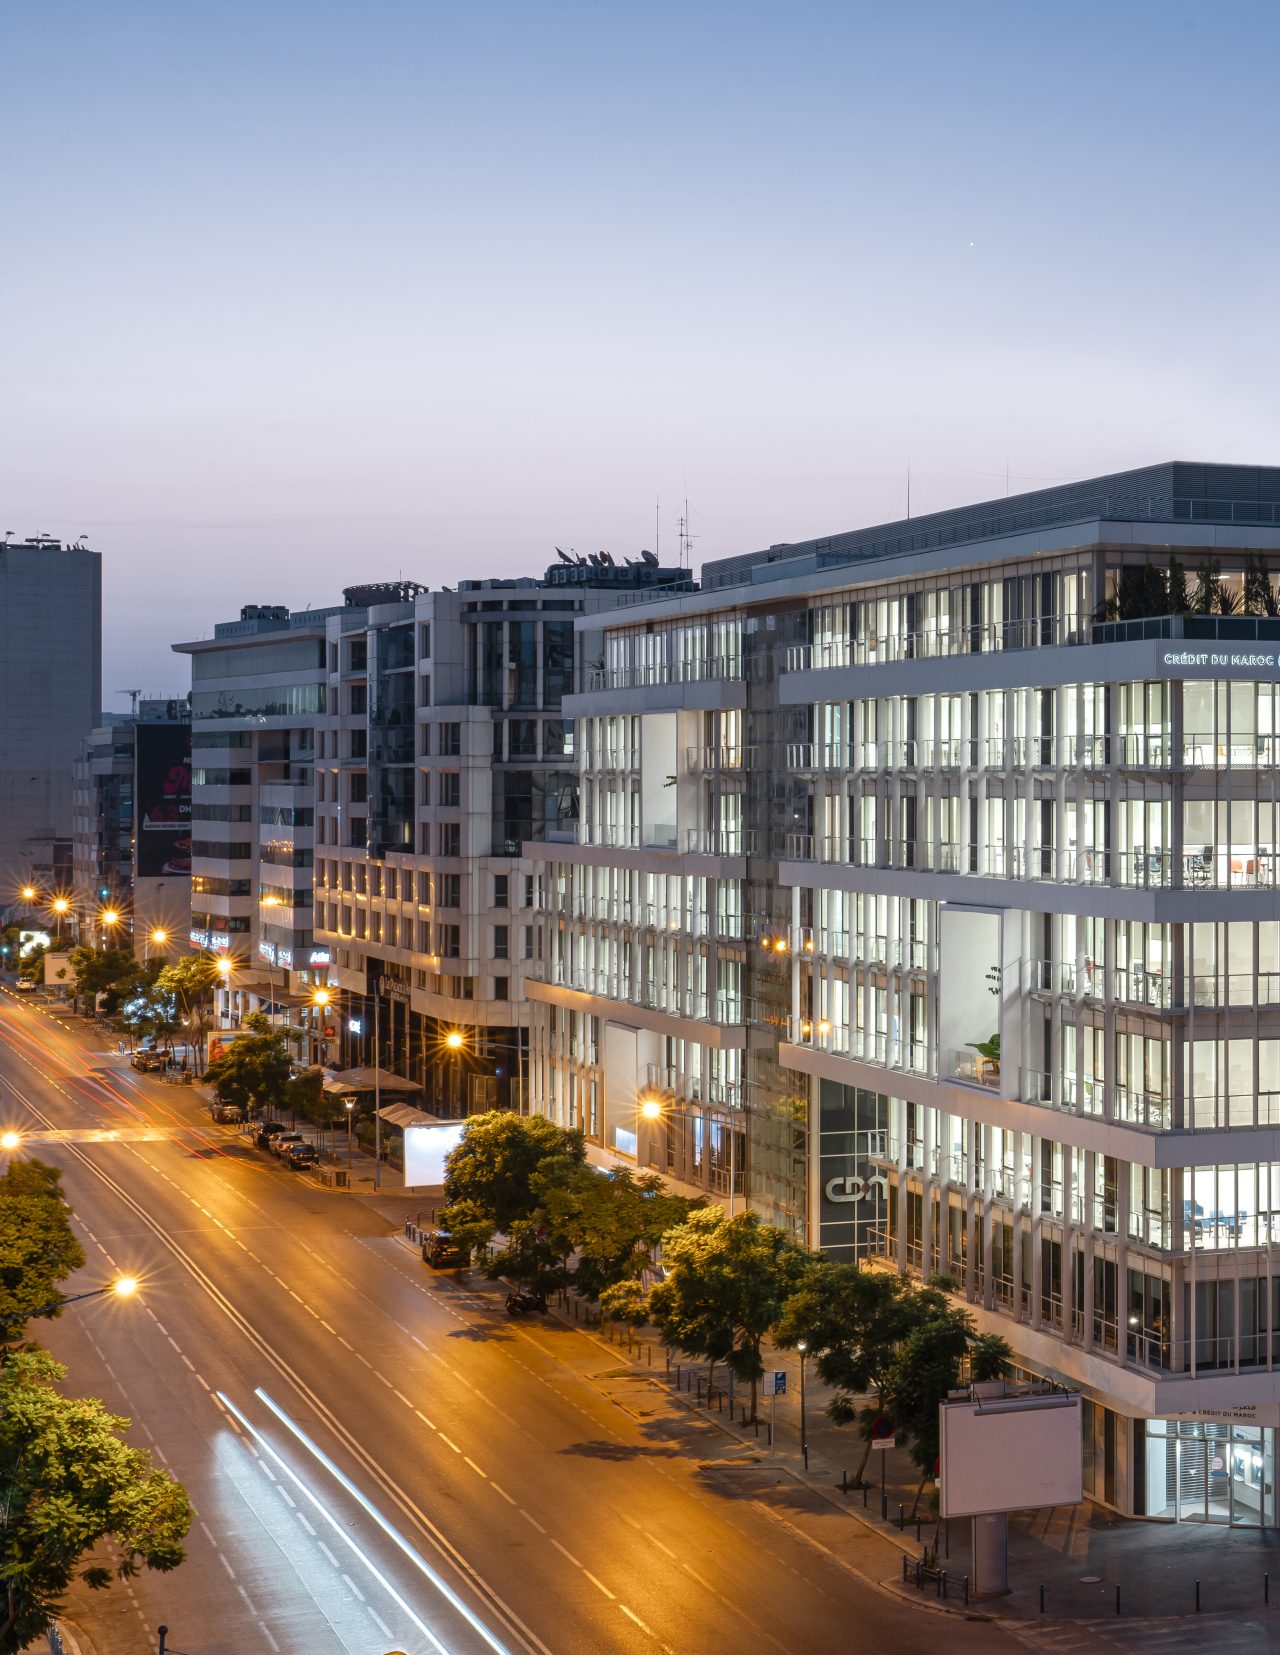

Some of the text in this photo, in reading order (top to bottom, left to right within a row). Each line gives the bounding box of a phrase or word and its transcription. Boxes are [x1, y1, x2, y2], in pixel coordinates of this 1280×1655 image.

[1164, 652, 1274, 666] CRÉDIT DU MAROC
